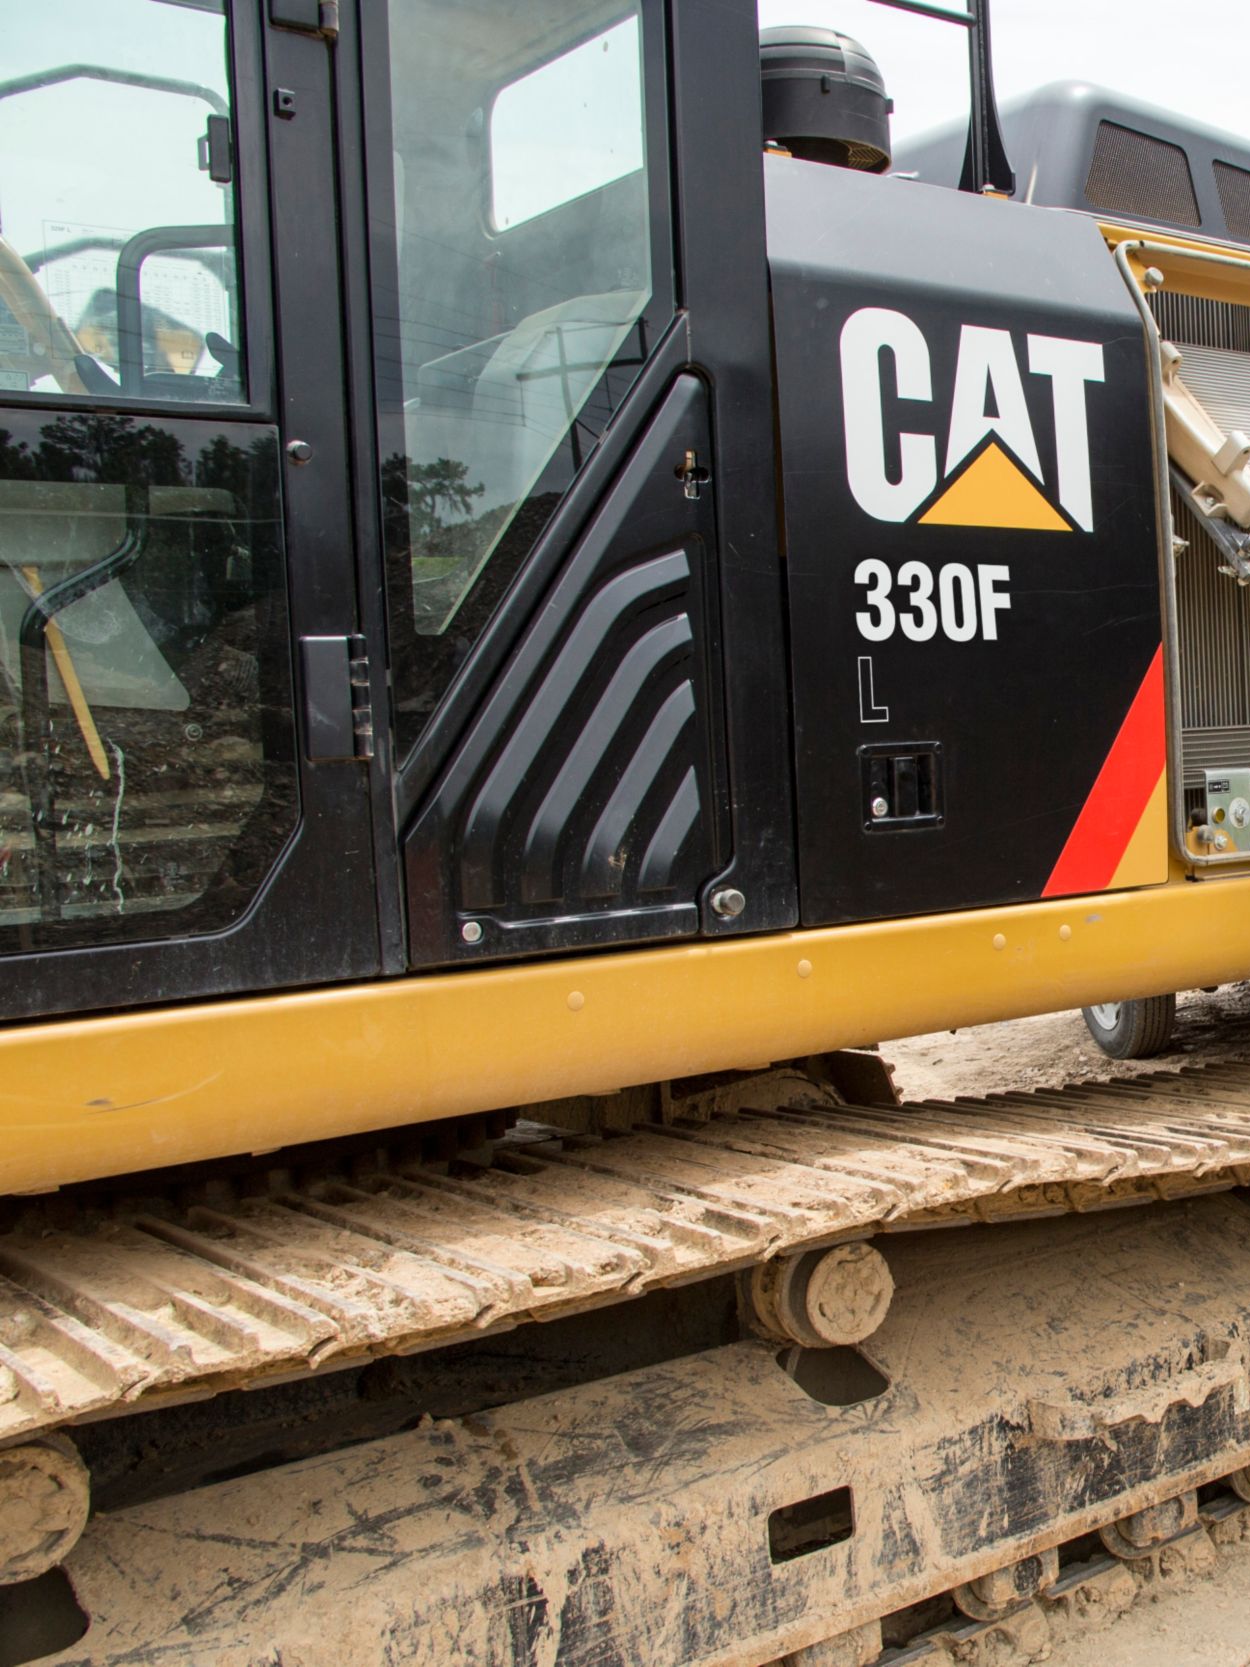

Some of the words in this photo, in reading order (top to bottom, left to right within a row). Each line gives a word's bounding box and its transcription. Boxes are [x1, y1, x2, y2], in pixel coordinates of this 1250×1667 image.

[839, 307, 1105, 533] CAT
[854, 558, 1012, 642] 330F
[857, 656, 889, 723] L
